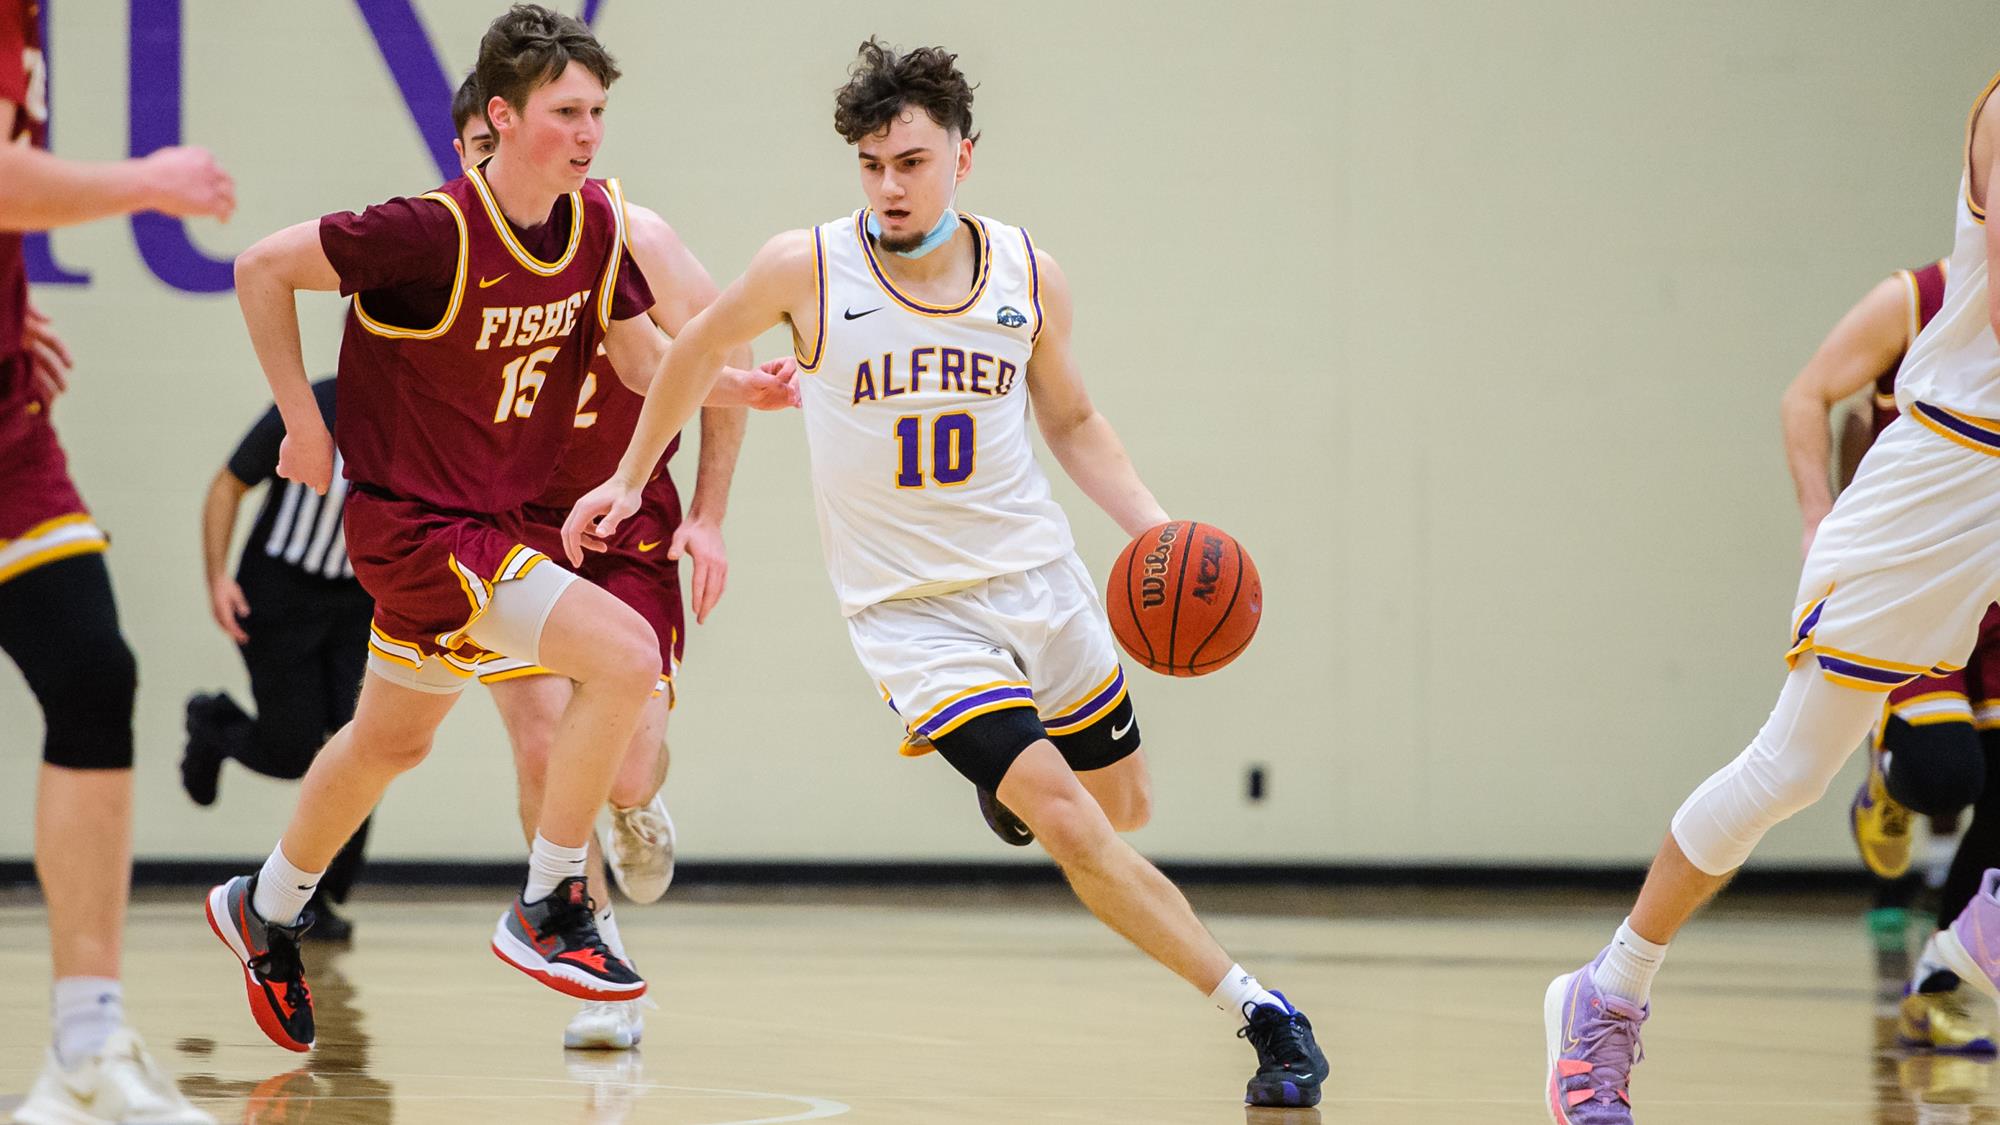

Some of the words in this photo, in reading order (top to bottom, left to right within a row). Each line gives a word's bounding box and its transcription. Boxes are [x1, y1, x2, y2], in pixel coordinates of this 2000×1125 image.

[494, 346, 561, 424] 15
[852, 346, 1017, 406] ALFRED
[893, 409, 977, 489] 10
[1141, 522, 1184, 610] Wilson
[1192, 535, 1223, 605] NCAA
